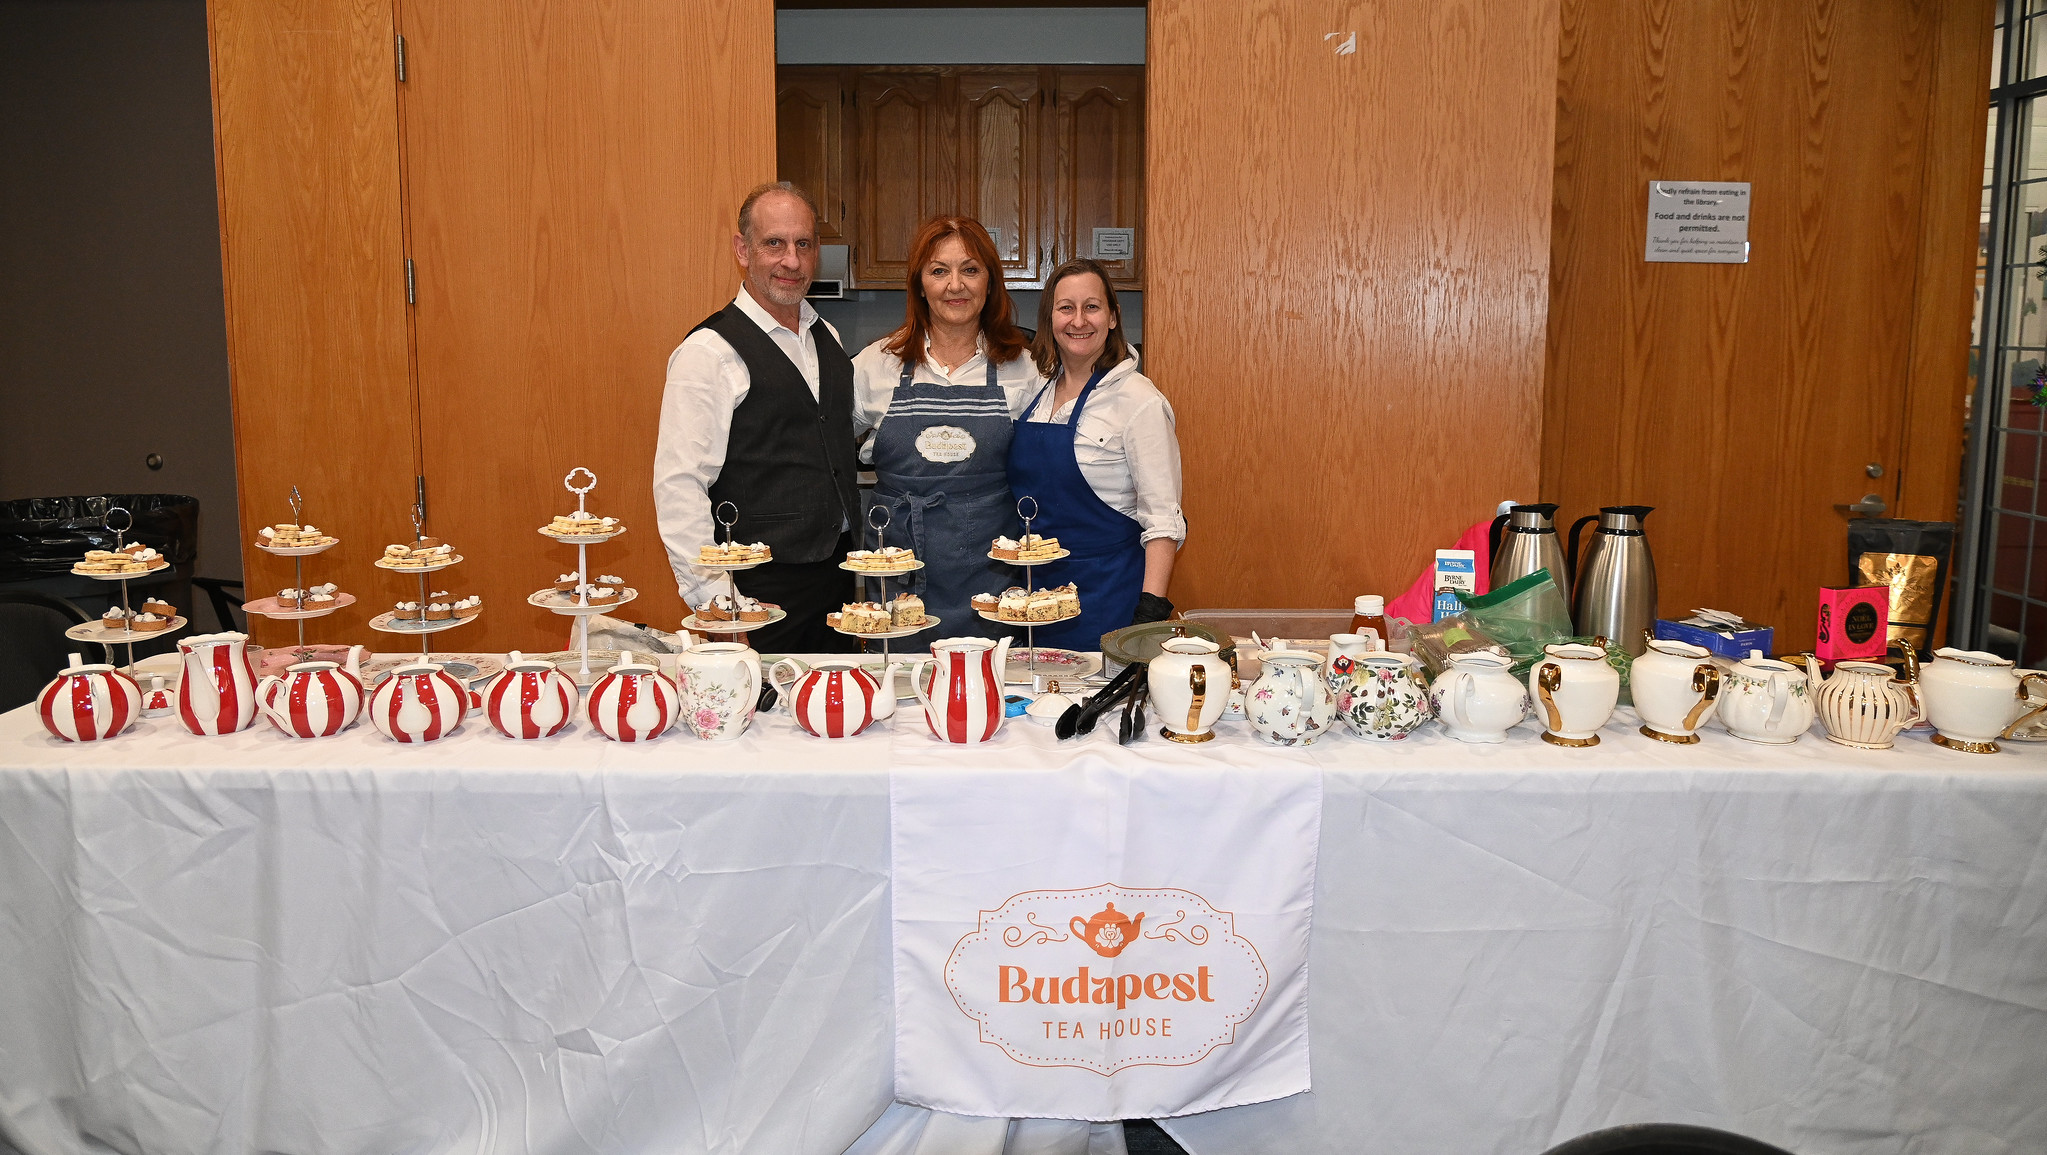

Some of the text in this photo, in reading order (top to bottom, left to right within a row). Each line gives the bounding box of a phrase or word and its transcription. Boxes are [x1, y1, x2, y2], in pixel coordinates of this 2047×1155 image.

[1656, 187, 1677, 196] ndly
[1701, 188, 1718, 196] from
[1718, 189, 1739, 197] eating
[1654, 212, 1675, 220] Food
[1675, 212, 1691, 220] and
[1692, 212, 1717, 221] drinks
[1678, 224, 1720, 232] permitted.
[1652, 236, 1670, 244] Thank
[1444, 574, 1463, 582] BYRNE
[998, 965, 1215, 1010] Budapest
[1042, 1018, 1172, 1040] TEA HOUSE
